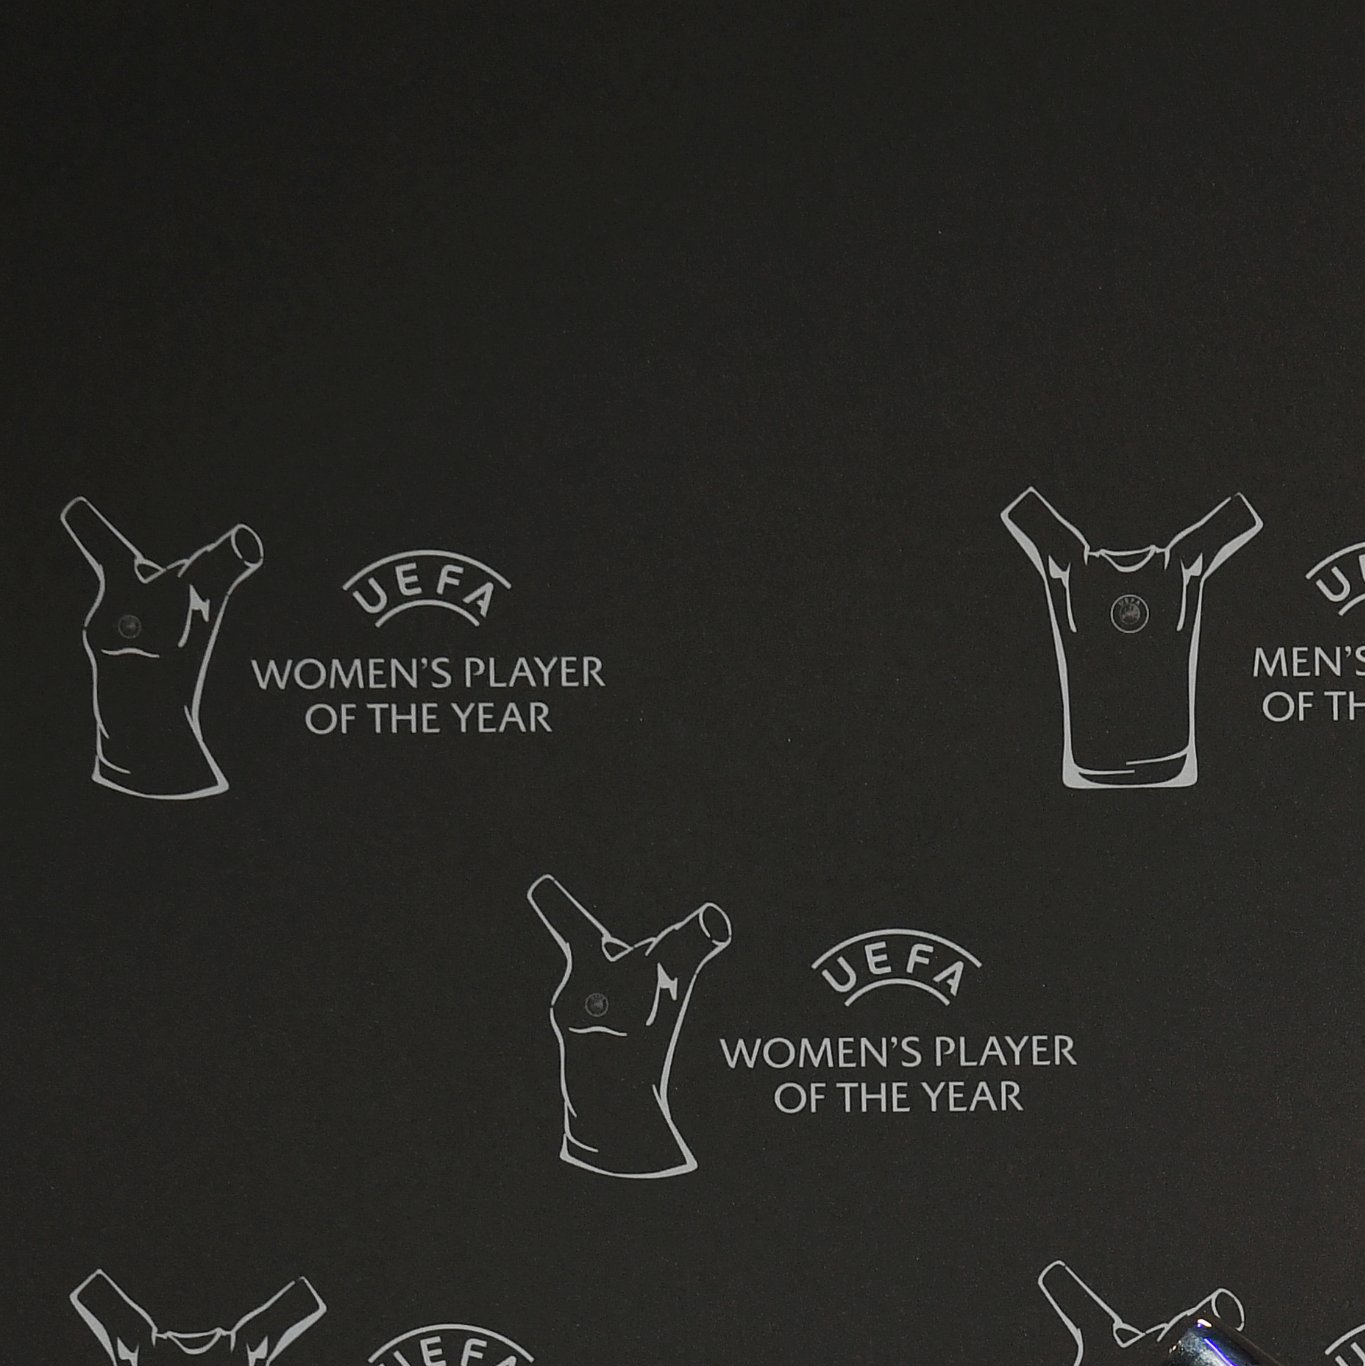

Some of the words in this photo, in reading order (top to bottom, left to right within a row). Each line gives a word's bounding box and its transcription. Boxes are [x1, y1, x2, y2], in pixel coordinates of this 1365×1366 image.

[353, 563, 493, 617] UEFA
[251, 657, 451, 689] WOMEN'S
[466, 657, 605, 687] PLAYER
[305, 704, 356, 734] OF
[367, 703, 440, 733] THE
[451, 702, 552, 732] YEAR
[1263, 692, 1313, 722] OF
[822, 942, 964, 996] UEFA
[720, 1036, 921, 1068] WOMEN'S
[936, 1035, 1077, 1066] PLAYER
[775, 1083, 826, 1113] OF
[836, 1082, 910, 1112] THE
[921, 1081, 1023, 1111] YEAR
